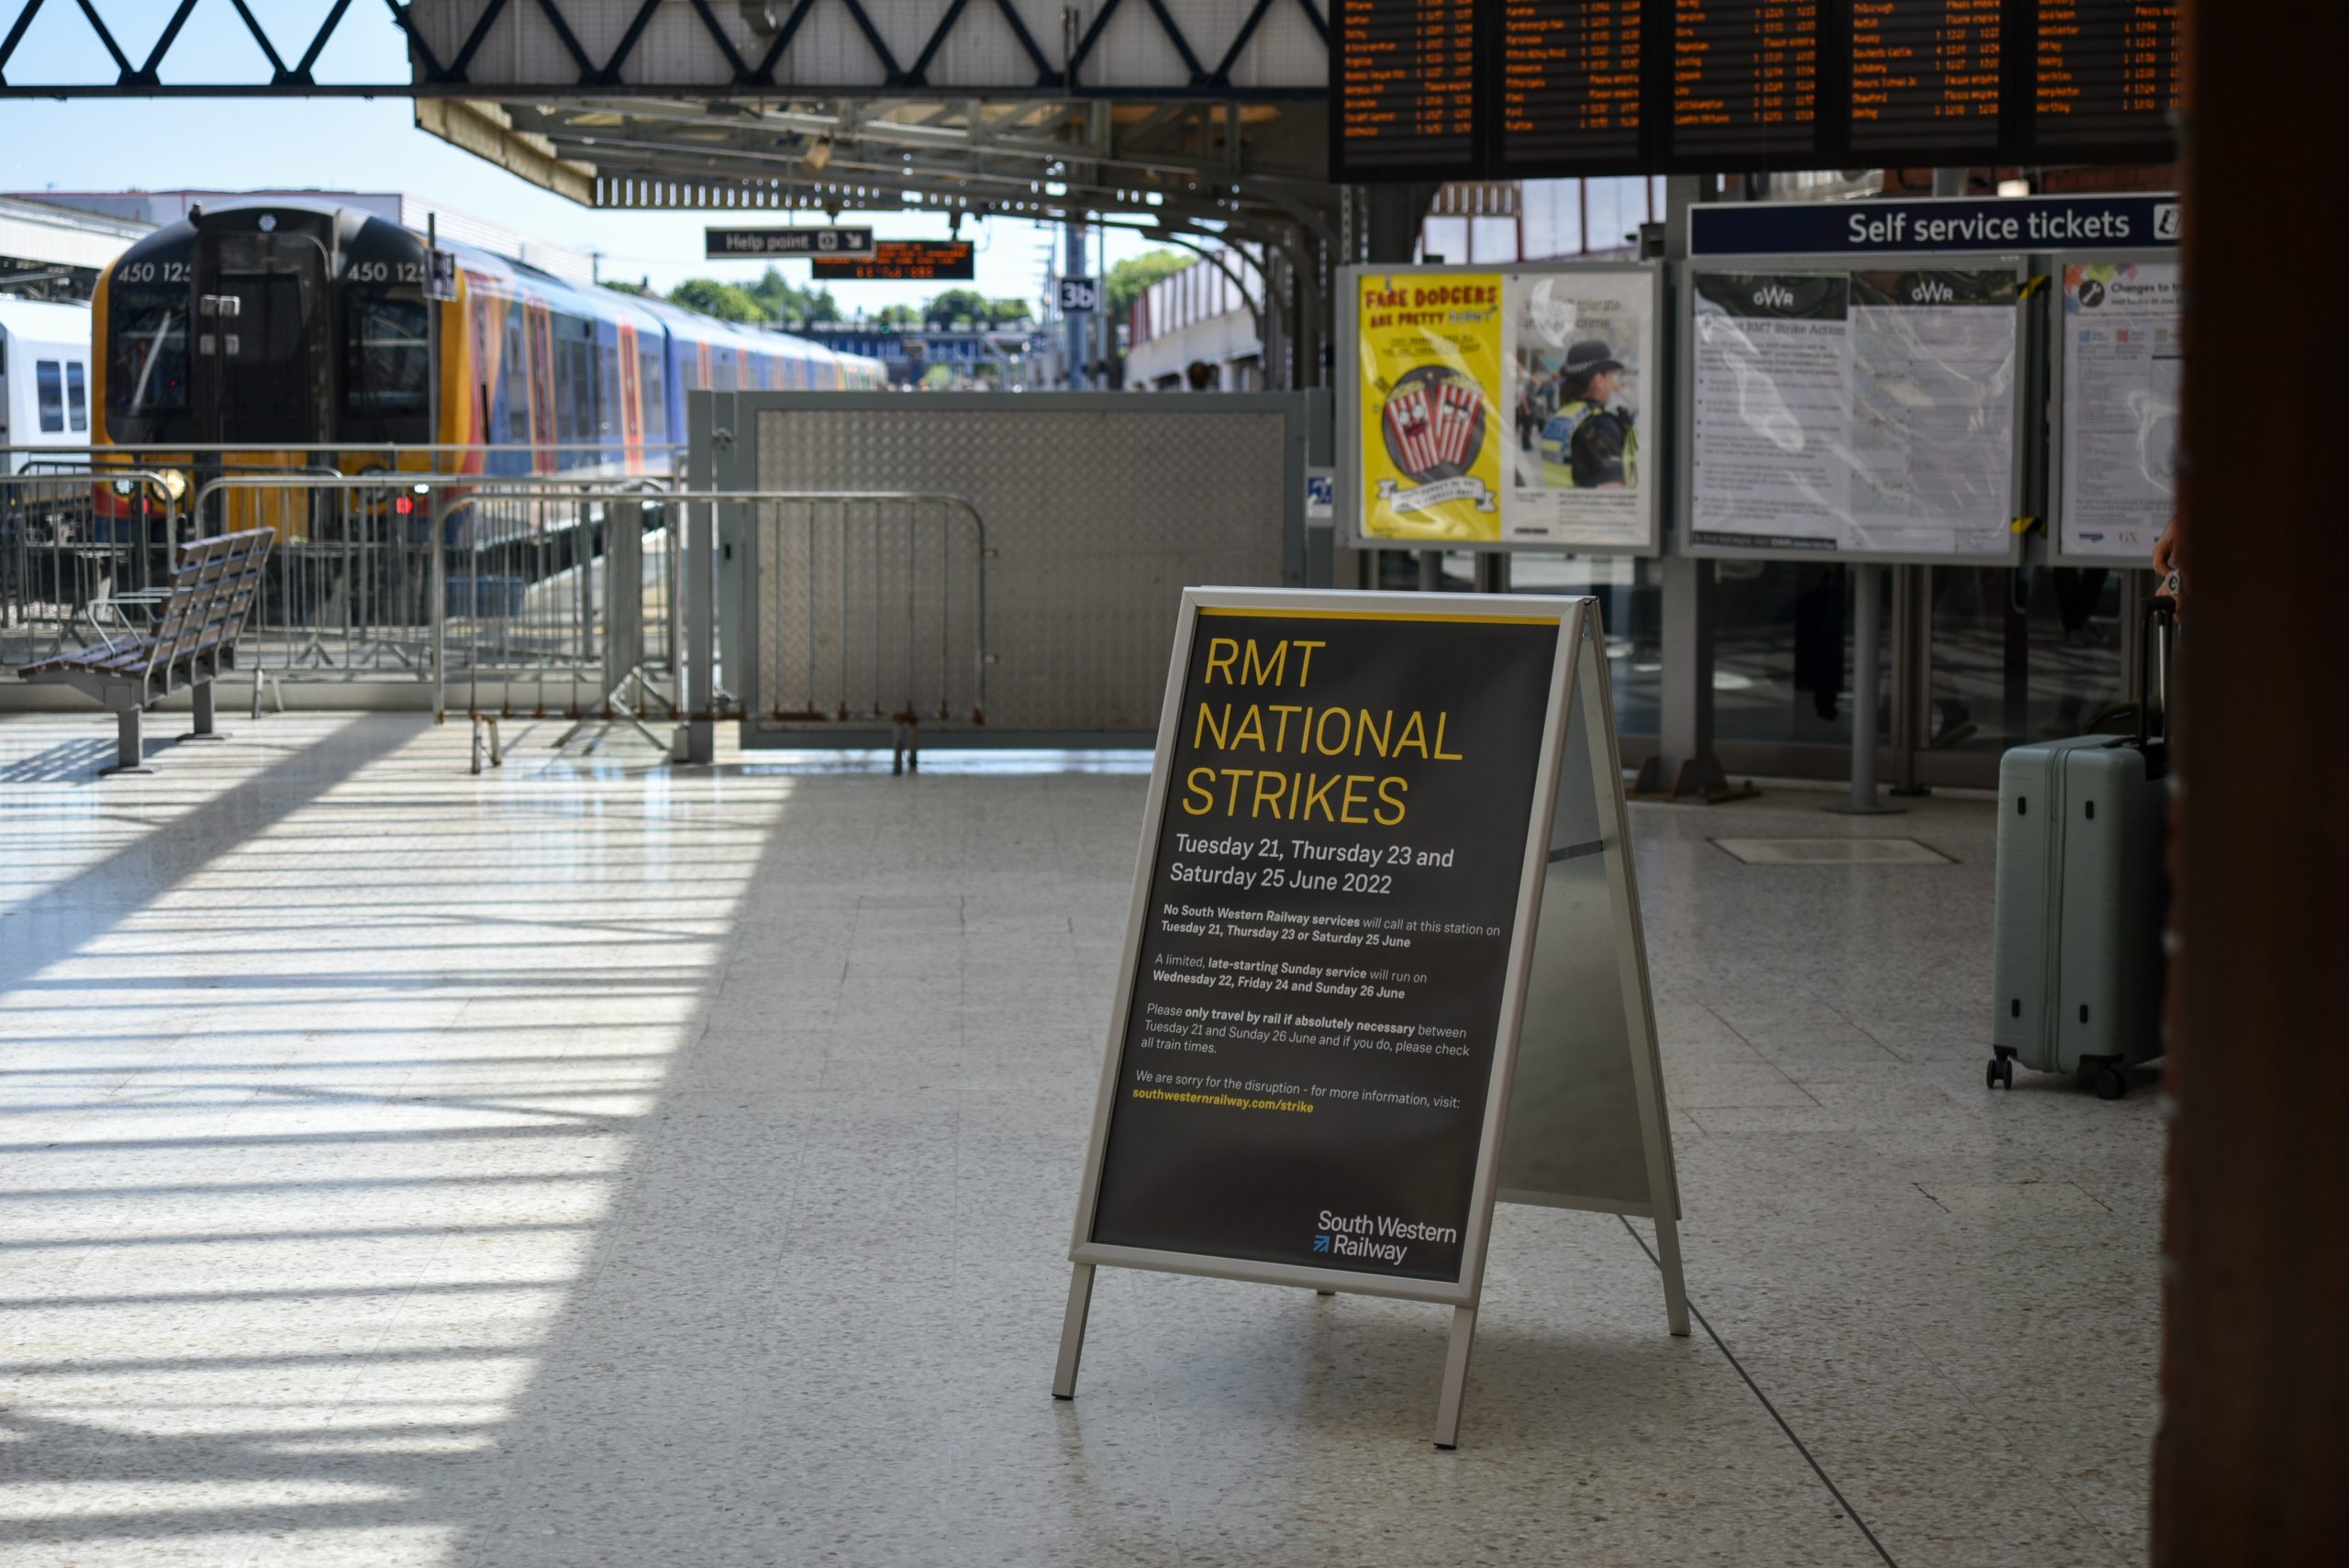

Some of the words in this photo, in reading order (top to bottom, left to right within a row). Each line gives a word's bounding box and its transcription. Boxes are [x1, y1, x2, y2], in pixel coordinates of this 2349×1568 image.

[1849, 212, 1907, 243] Self
[1914, 213, 2020, 242] service
[2027, 209, 2131, 239] tickets
[726, 233, 763, 252] Help
[767, 232, 809, 252] point
[117, 261, 156, 283] 450
[347, 261, 388, 283] 450
[1061, 282, 1096, 308] 3b
[1365, 288, 1408, 310] FARE
[1415, 284, 1497, 308] DODGERS
[1753, 284, 1795, 309] GWR
[1911, 279, 1954, 305] GWR
[2110, 282, 2154, 295] Changes
[1397, 310, 1446, 328] PRETTY
[1205, 638, 1326, 687] RMT
[1194, 703, 1463, 760] NATIONAL
[1183, 767, 1408, 825] STRIKES
[1176, 833, 1254, 860] Tuesday
[1258, 839, 1284, 861] 21,
[1292, 840, 1383, 868] Thursday
[1387, 846, 1411, 864] 23
[1417, 849, 1454, 867] and
[1171, 862, 1257, 890] Saturday
[1261, 868, 1285, 887] 25
[1289, 870, 1337, 890] June
[1342, 873, 1392, 894] 2022
[1162, 920, 1206, 936] Tuesday
[1208, 924, 1223, 937] 21,
[1228, 925, 1279, 941] Thursday
[1281, 929, 1295, 940] 23
[1297, 932, 1309, 940] or
[1312, 930, 1364, 947] Saturday
[1365, 934, 1379, 945] 25
[1382, 935, 1410, 947] June
[1163, 904, 1178, 915] No
[1181, 905, 1214, 917] South
[1218, 907, 1264, 920] Western
[1266, 910, 1310, 926] Railway
[1312, 915, 1360, 927] services
[1364, 917, 1381, 928] will
[1384, 918, 1403, 929] call
[1406, 921, 1418, 930] at
[1421, 921, 1441, 932] this
[1444, 923, 1483, 935] station
[1155, 953, 1163, 964] A
[1166, 954, 1205, 969] limited,
[1208, 957, 1278, 975] late-starting
[1281, 962, 1323, 978] Sunday
[1326, 967, 1366, 979] service
[1370, 969, 1388, 980] will
[1392, 973, 1410, 982] run
[1414, 974, 1427, 983] on
[1153, 970, 1217, 987] Wednesday
[1219, 975, 1234, 988] 22,
[1238, 976, 1273, 992] Friday
[1275, 979, 1288, 990] 24
[1291, 982, 1313, 992] and
[1315, 982, 1357, 997] Sunday
[1360, 985, 1375, 996] 26
[1376, 986, 1405, 999] June
[1147, 1003, 1182, 1017] Please
[1186, 1007, 1209, 1020] only
[1211, 1009, 1244, 1021] travel
[1247, 1011, 1260, 1025] by
[1263, 1013, 1281, 1024] rail
[1284, 1014, 1293, 1025] if
[1295, 1015, 1353, 1032] absolutely
[1356, 1022, 1415, 1037] necessary
[1418, 1024, 1466, 1039] between
[1141, 1037, 1153, 1048] all
[1156, 1039, 1181, 1050] train
[1185, 1040, 1216, 1053] times.
[1145, 1020, 1189, 1036] Tuesday
[1191, 1024, 1202, 1035] 21
[1206, 1026, 1226, 1037] and
[1229, 1027, 1270, 1042] Sunday
[1272, 1030, 1286, 1041] 26
[1289, 1032, 1316, 1044] June
[1319, 1035, 1340, 1046] and
[1343, 1036, 1351, 1047] if
[1353, 1040, 1373, 1050] you
[1376, 1039, 1392, 1051] do,
[1396, 1040, 1432, 1053] please
[1435, 1043, 1469, 1056] check
[1133, 1089, 1313, 1113] southwesternrailway.com/strike
[1137, 1070, 1152, 1082] We
[1155, 1074, 1173, 1084] are
[1175, 1076, 1203, 1088] sorry
[1207, 1076, 1221, 1087] for
[1224, 1078, 1241, 1089] the
[1245, 1080, 1299, 1095] disruption
[1311, 1084, 1327, 1096] for
[1330, 1089, 1359, 1099] more
[1363, 1089, 1430, 1107] information,
[1434, 1096, 1460, 1108] visit:
[1319, 1210, 1374, 1235] South
[1378, 1216, 1456, 1243] Western
[1334, 1234, 1408, 1265] Railway
